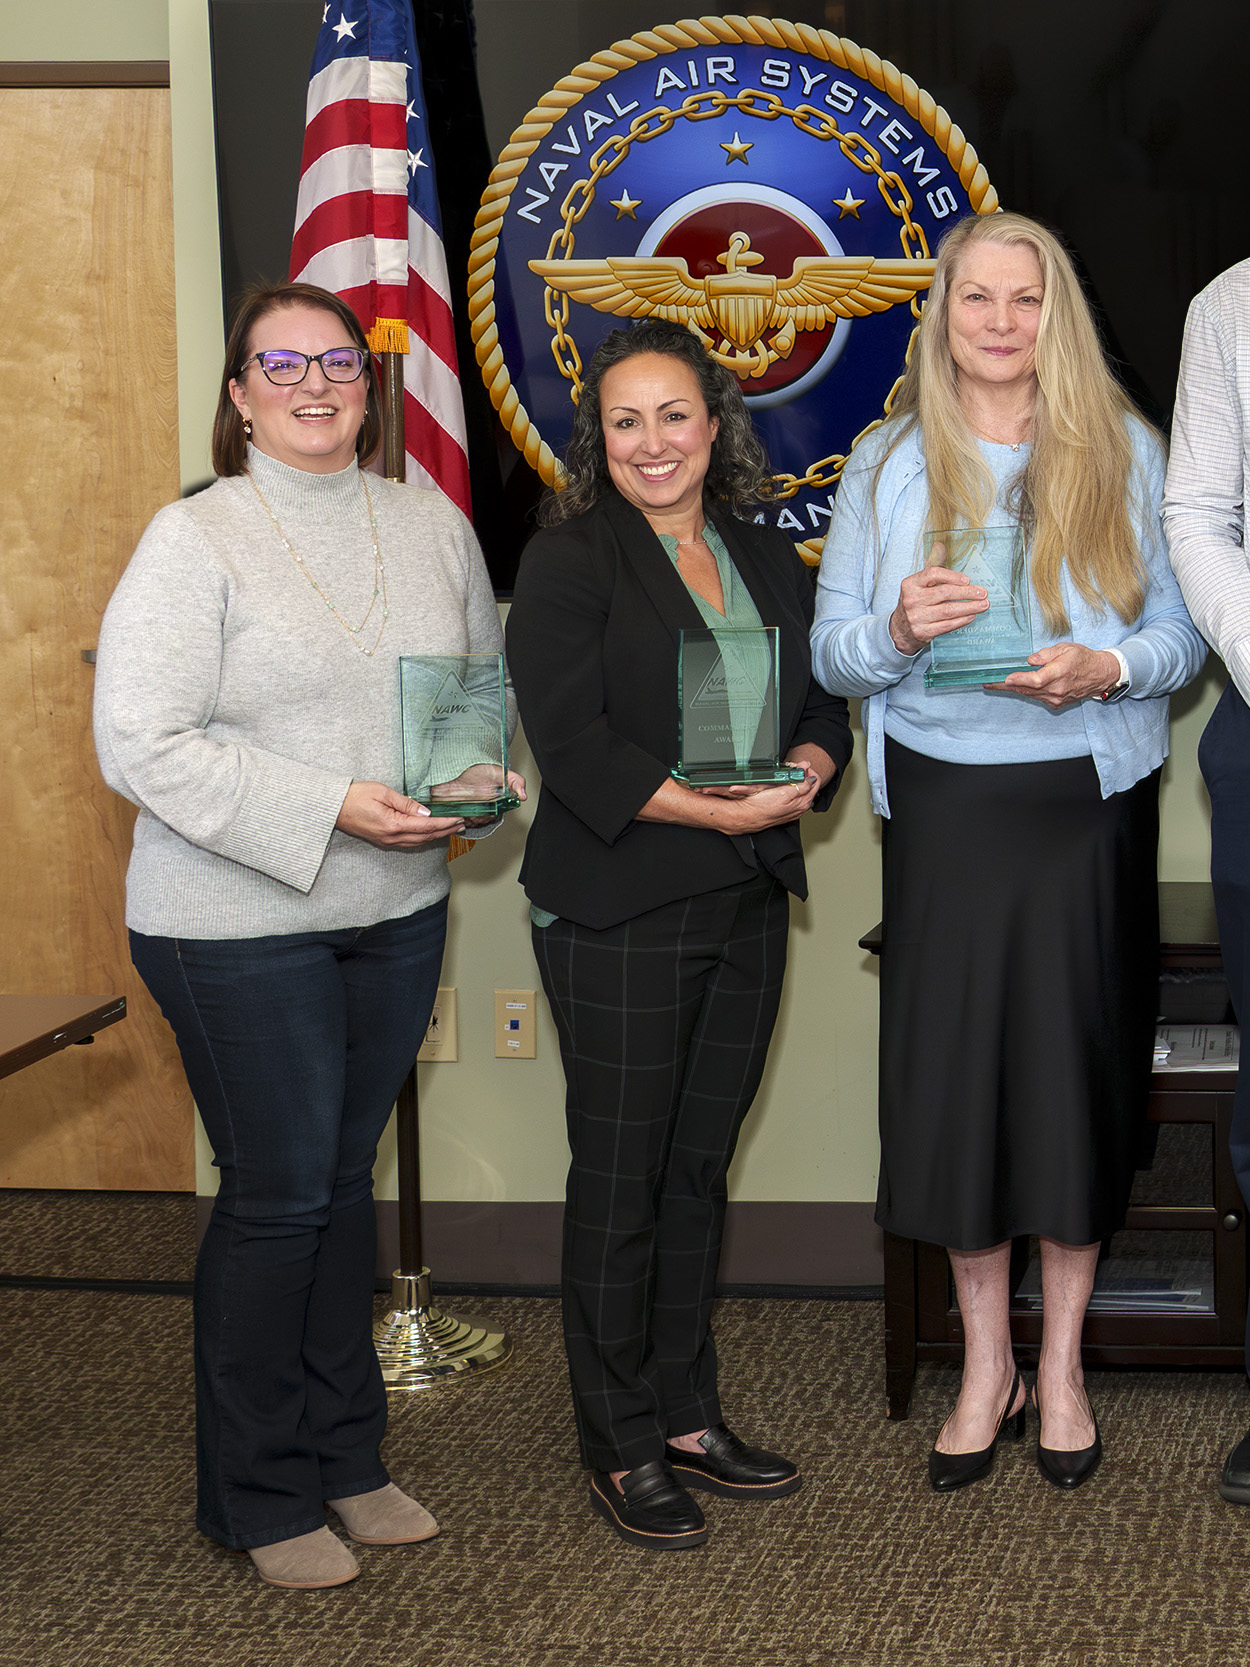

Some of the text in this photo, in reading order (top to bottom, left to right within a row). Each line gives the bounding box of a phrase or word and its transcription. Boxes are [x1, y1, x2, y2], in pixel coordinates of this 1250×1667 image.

[517, 56, 959, 224] NAVAL AIR SYSTEMS
[432, 704, 472, 715] NAWC
